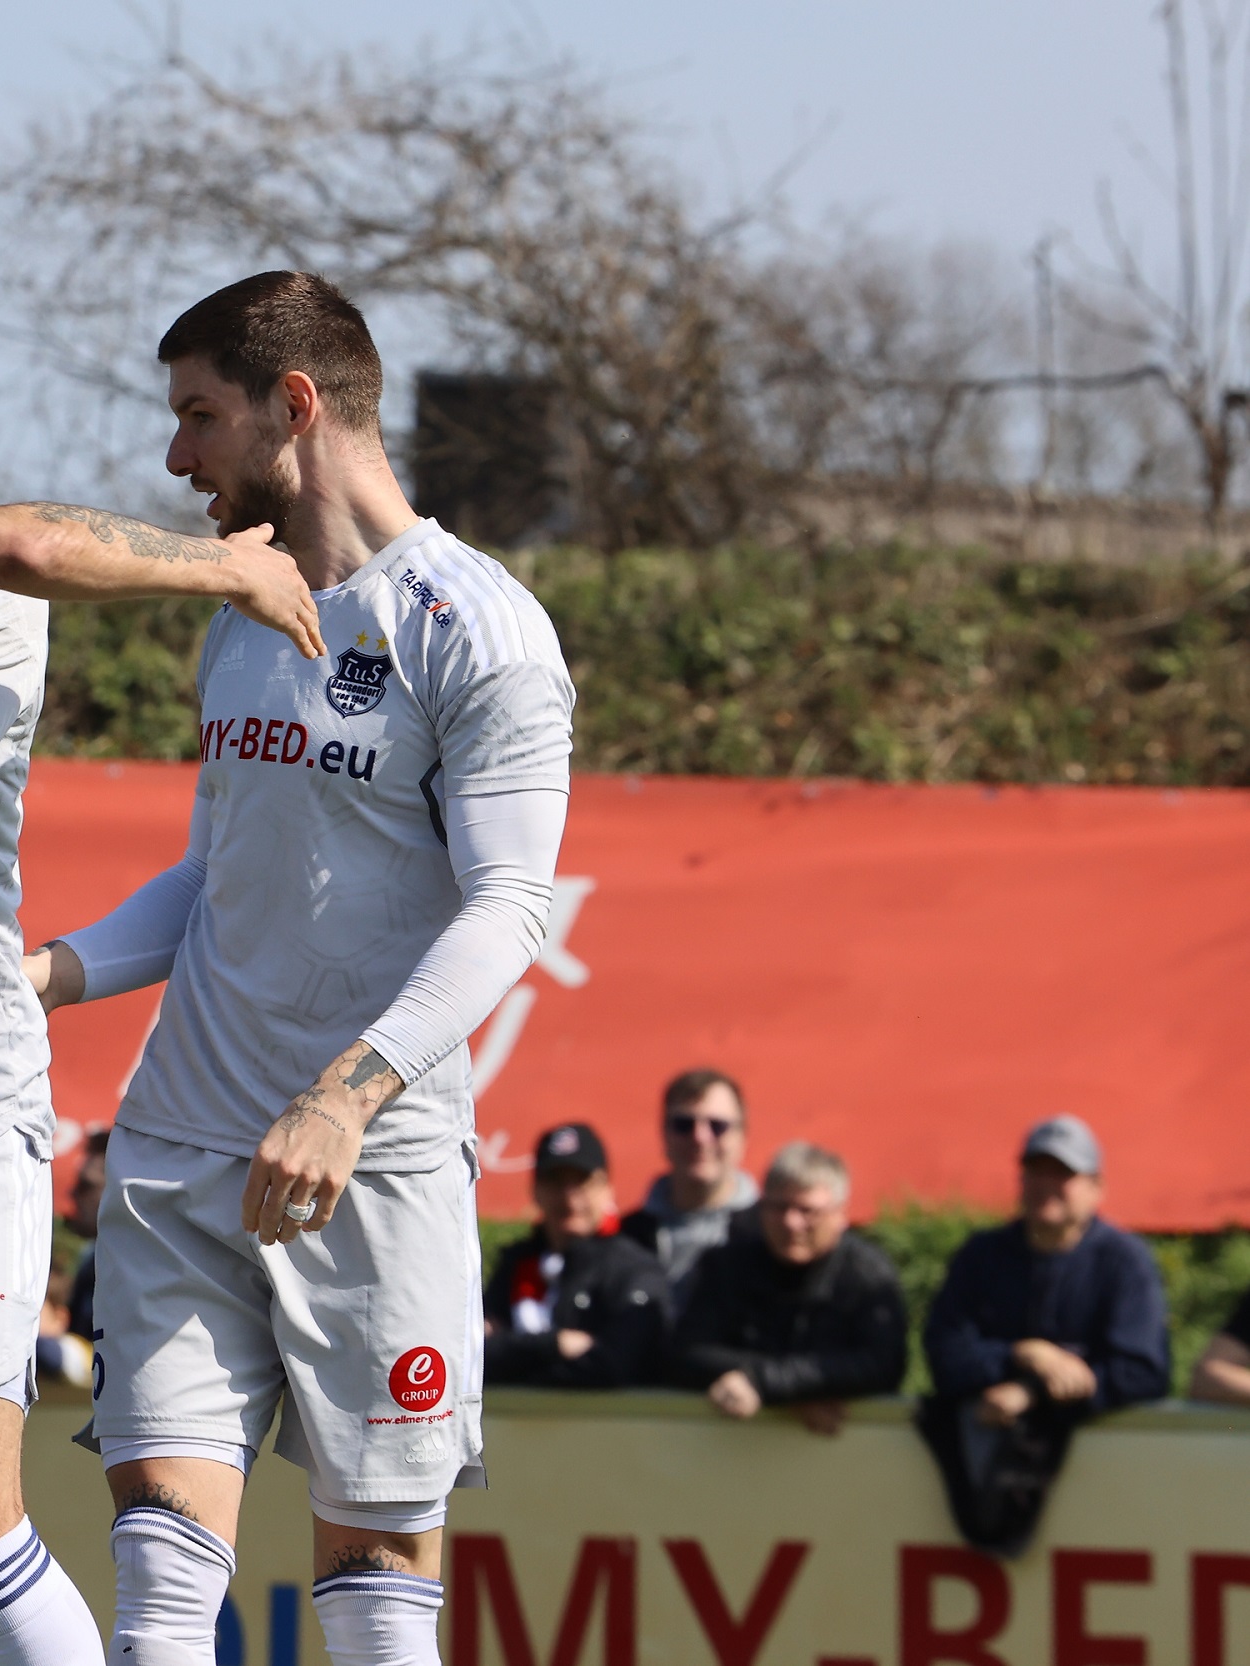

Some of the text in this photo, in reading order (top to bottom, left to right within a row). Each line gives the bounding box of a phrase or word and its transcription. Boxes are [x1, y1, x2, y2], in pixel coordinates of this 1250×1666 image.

[344, 657, 384, 684] TuS
[330, 679, 381, 698] Dassendorf
[310, 1105, 347, 1133] SCINTILLA
[401, 1388, 439, 1402] GROUP
